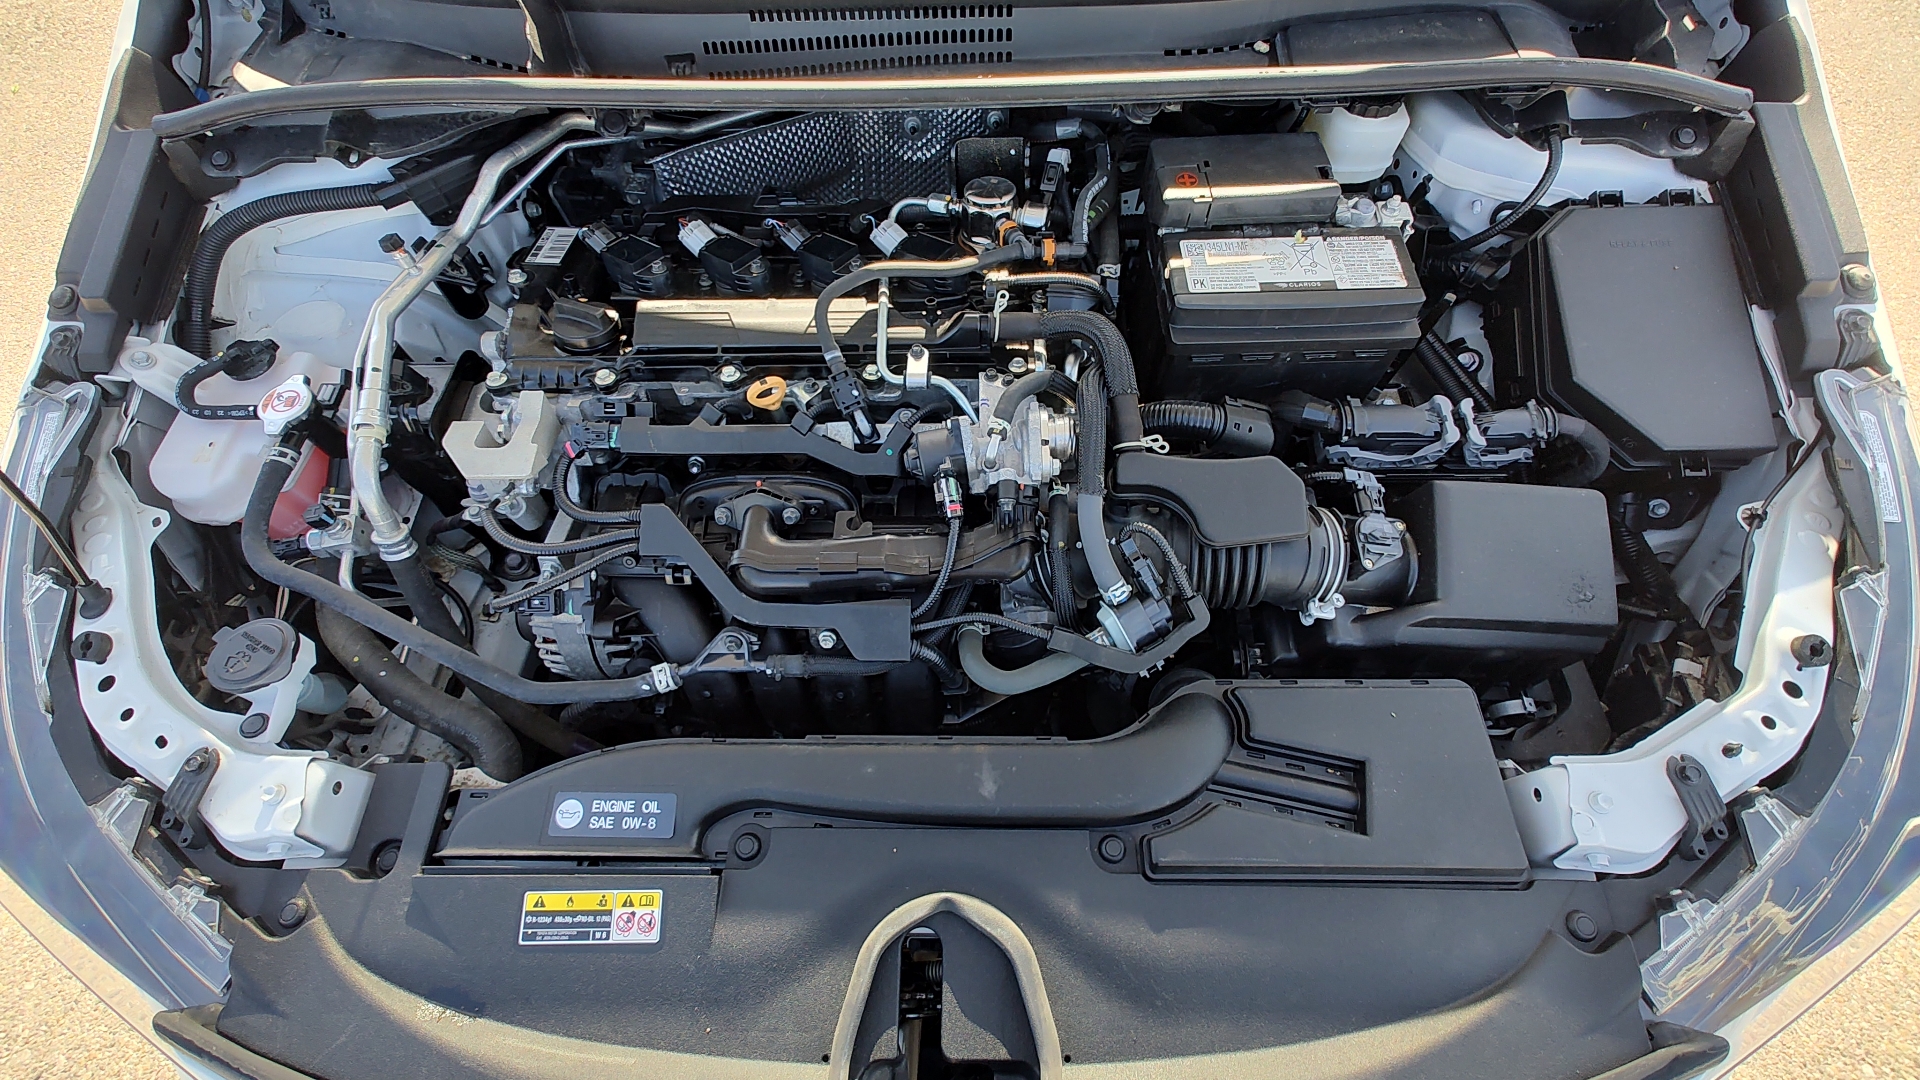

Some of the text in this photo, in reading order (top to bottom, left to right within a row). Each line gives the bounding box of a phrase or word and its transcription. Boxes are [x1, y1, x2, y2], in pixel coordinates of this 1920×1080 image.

[1206, 241, 1249, 252] 345LN1-MF
[1303, 268, 1318, 276] Pb
[1192, 278, 1207, 289] PK
[591, 800, 662, 814] ENGINE OIL
[589, 816, 656, 829] SAE 0W-8
